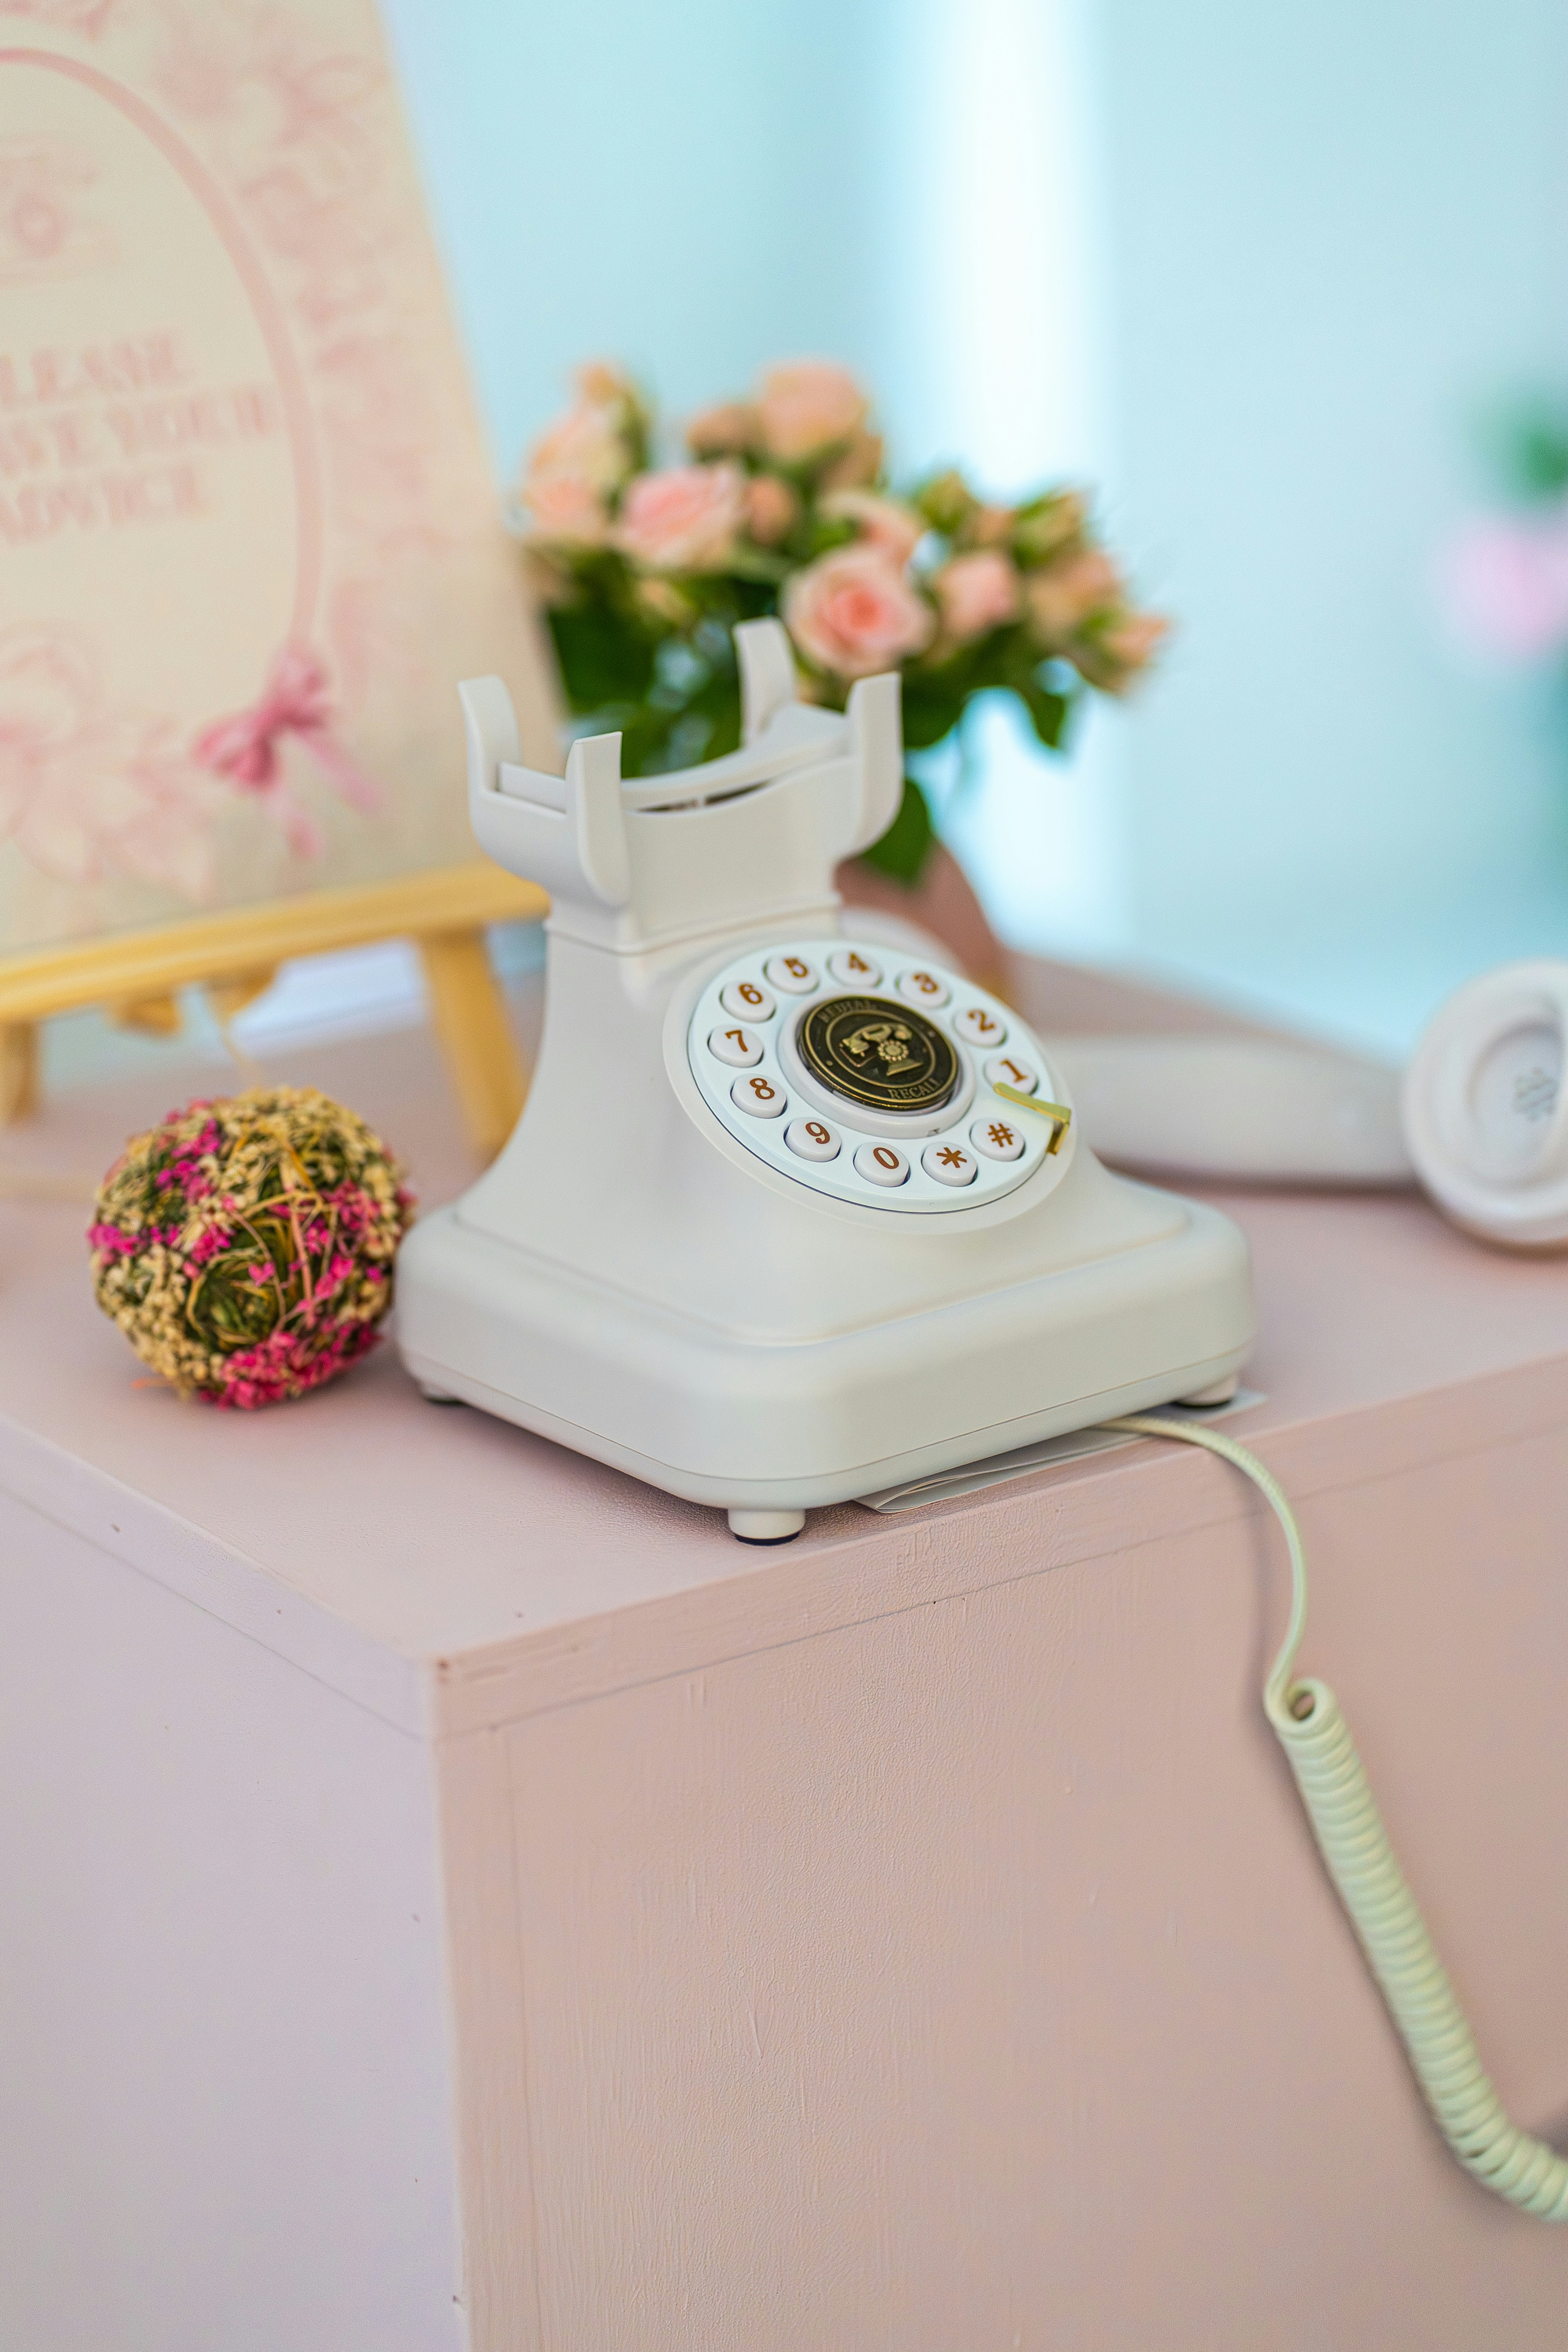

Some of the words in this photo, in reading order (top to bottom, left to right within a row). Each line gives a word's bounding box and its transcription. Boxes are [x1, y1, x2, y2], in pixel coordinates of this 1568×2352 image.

[784, 958, 808, 978] 5
[849, 953, 869, 973] 4
[739, 984, 763, 1005] 6
[913, 974, 938, 994] 3
[968, 1010, 995, 1032] 2
[725, 1030, 748, 1052] 7
[1000, 1060, 1027, 1083] 1
[750, 1078, 774, 1099] 8
[806, 1123, 830, 1143] 9
